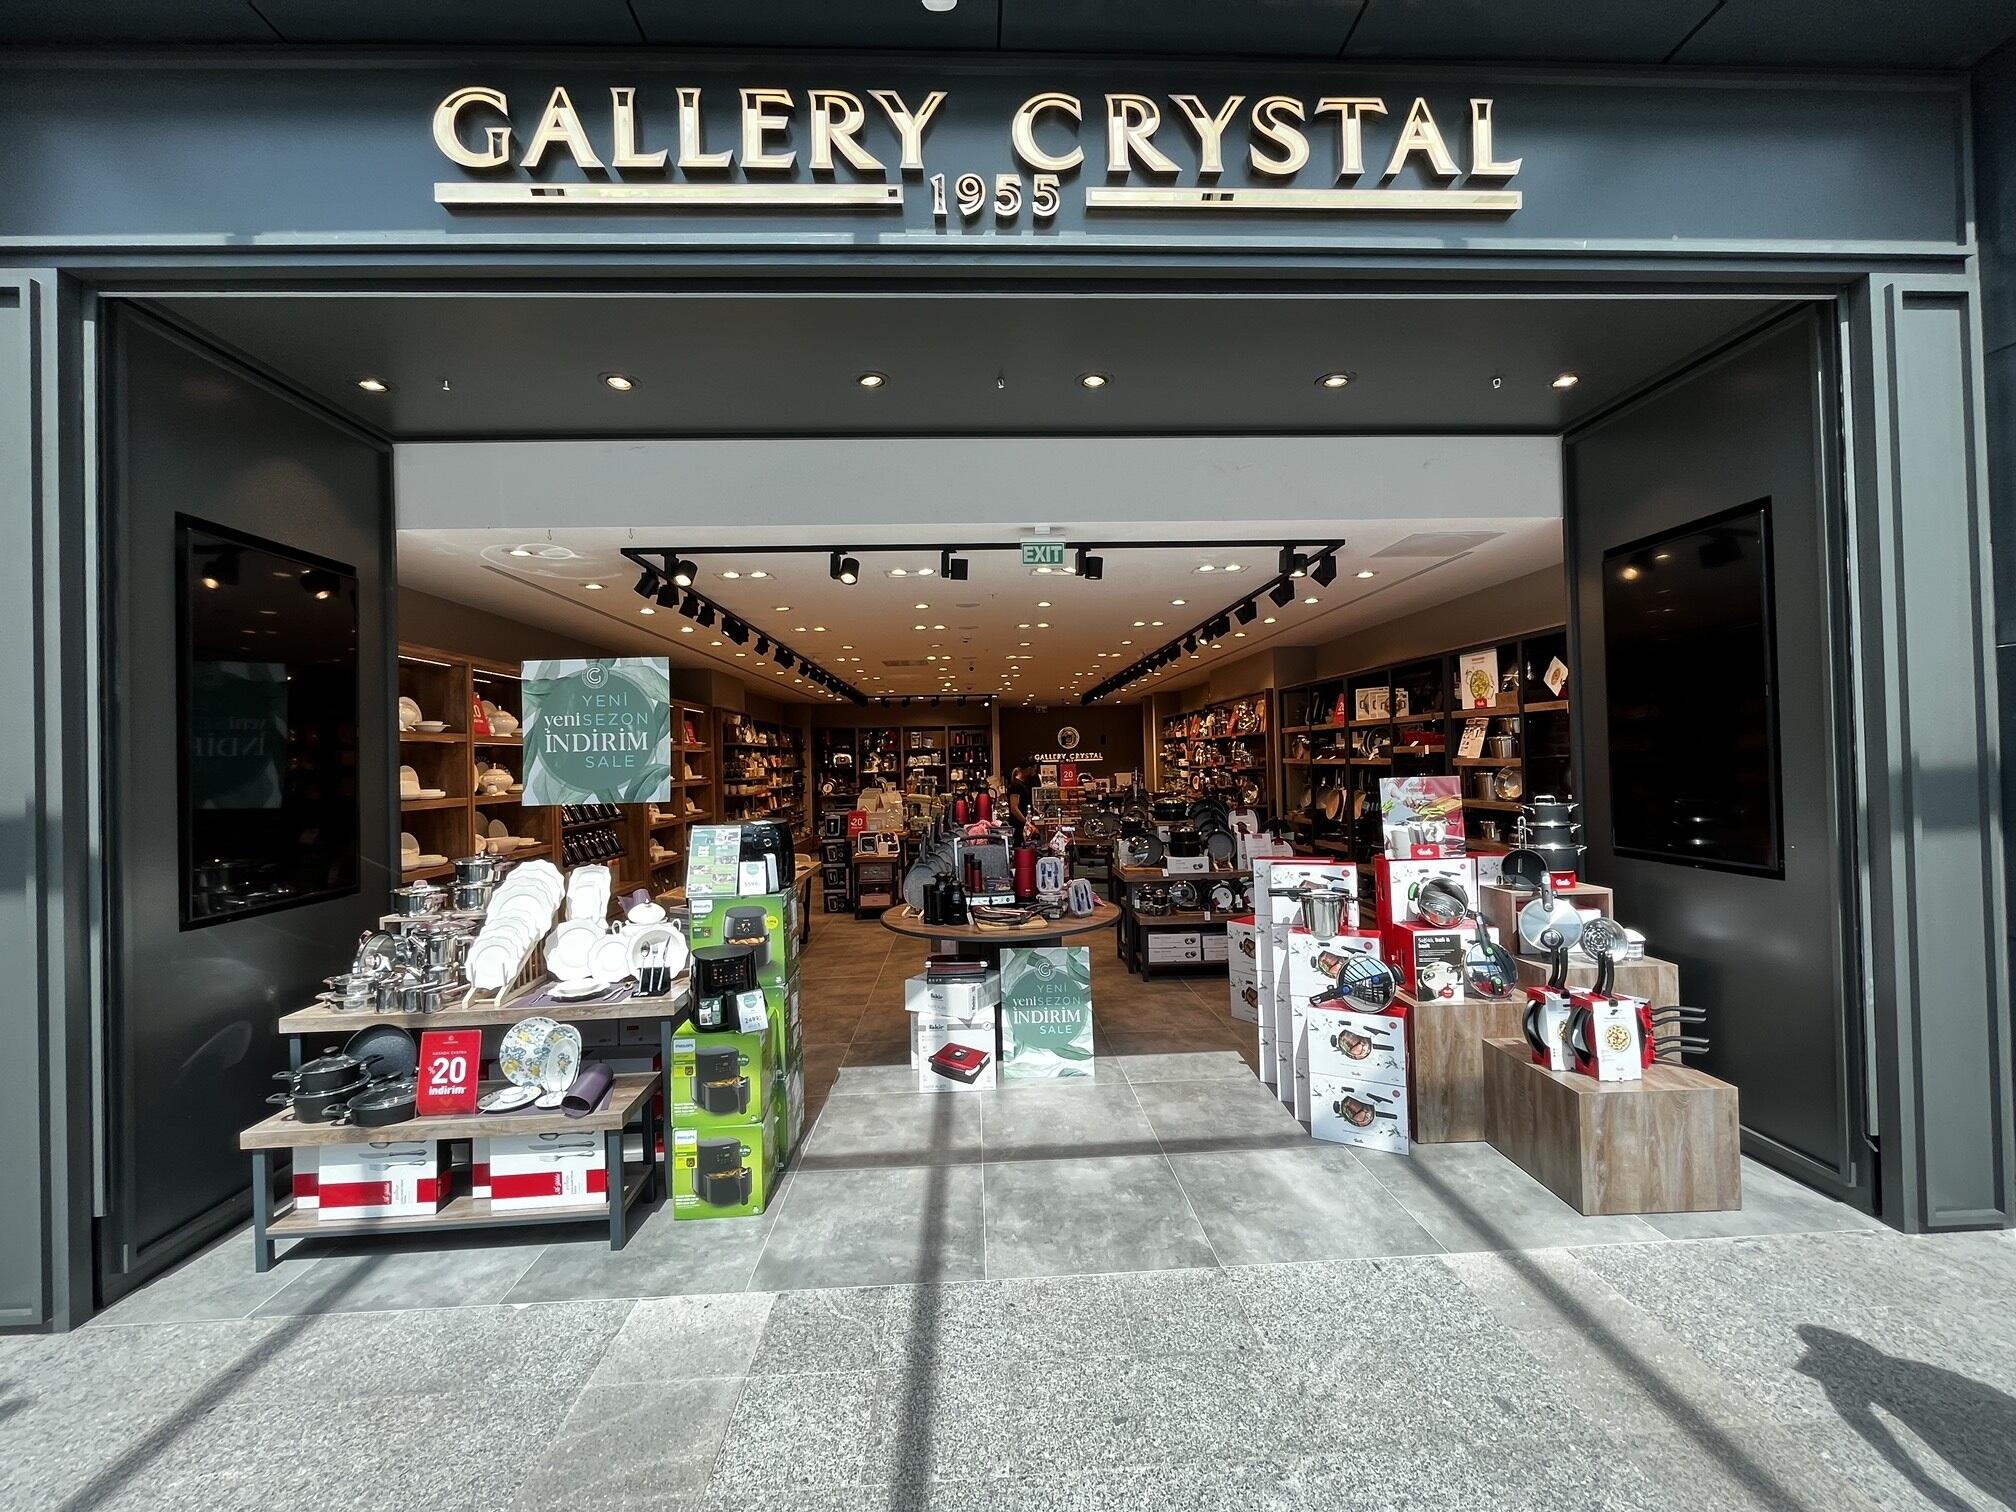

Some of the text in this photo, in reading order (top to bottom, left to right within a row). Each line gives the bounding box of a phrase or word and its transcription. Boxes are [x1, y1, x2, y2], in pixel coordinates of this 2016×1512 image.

[433, 86, 1523, 177] GALLERY CRYSTAL
[930, 172, 1061, 217] 1955
[1023, 545, 1062, 563] EXIT
[582, 692, 628, 707] YENİ
[544, 712, 649, 731] yeni SEZON
[544, 728, 649, 753] İNDİRİM
[585, 754, 635, 769] SALE
[1034, 753, 1066, 761] GALLERY
[1070, 752, 1103, 760] CRYSTAL
[1037, 996, 1081, 1006] SEZON
[1013, 1007, 1081, 1024] İNDİRİM
[1039, 1025, 1072, 1034] SALE
[429, 1085, 466, 1096] indirim
